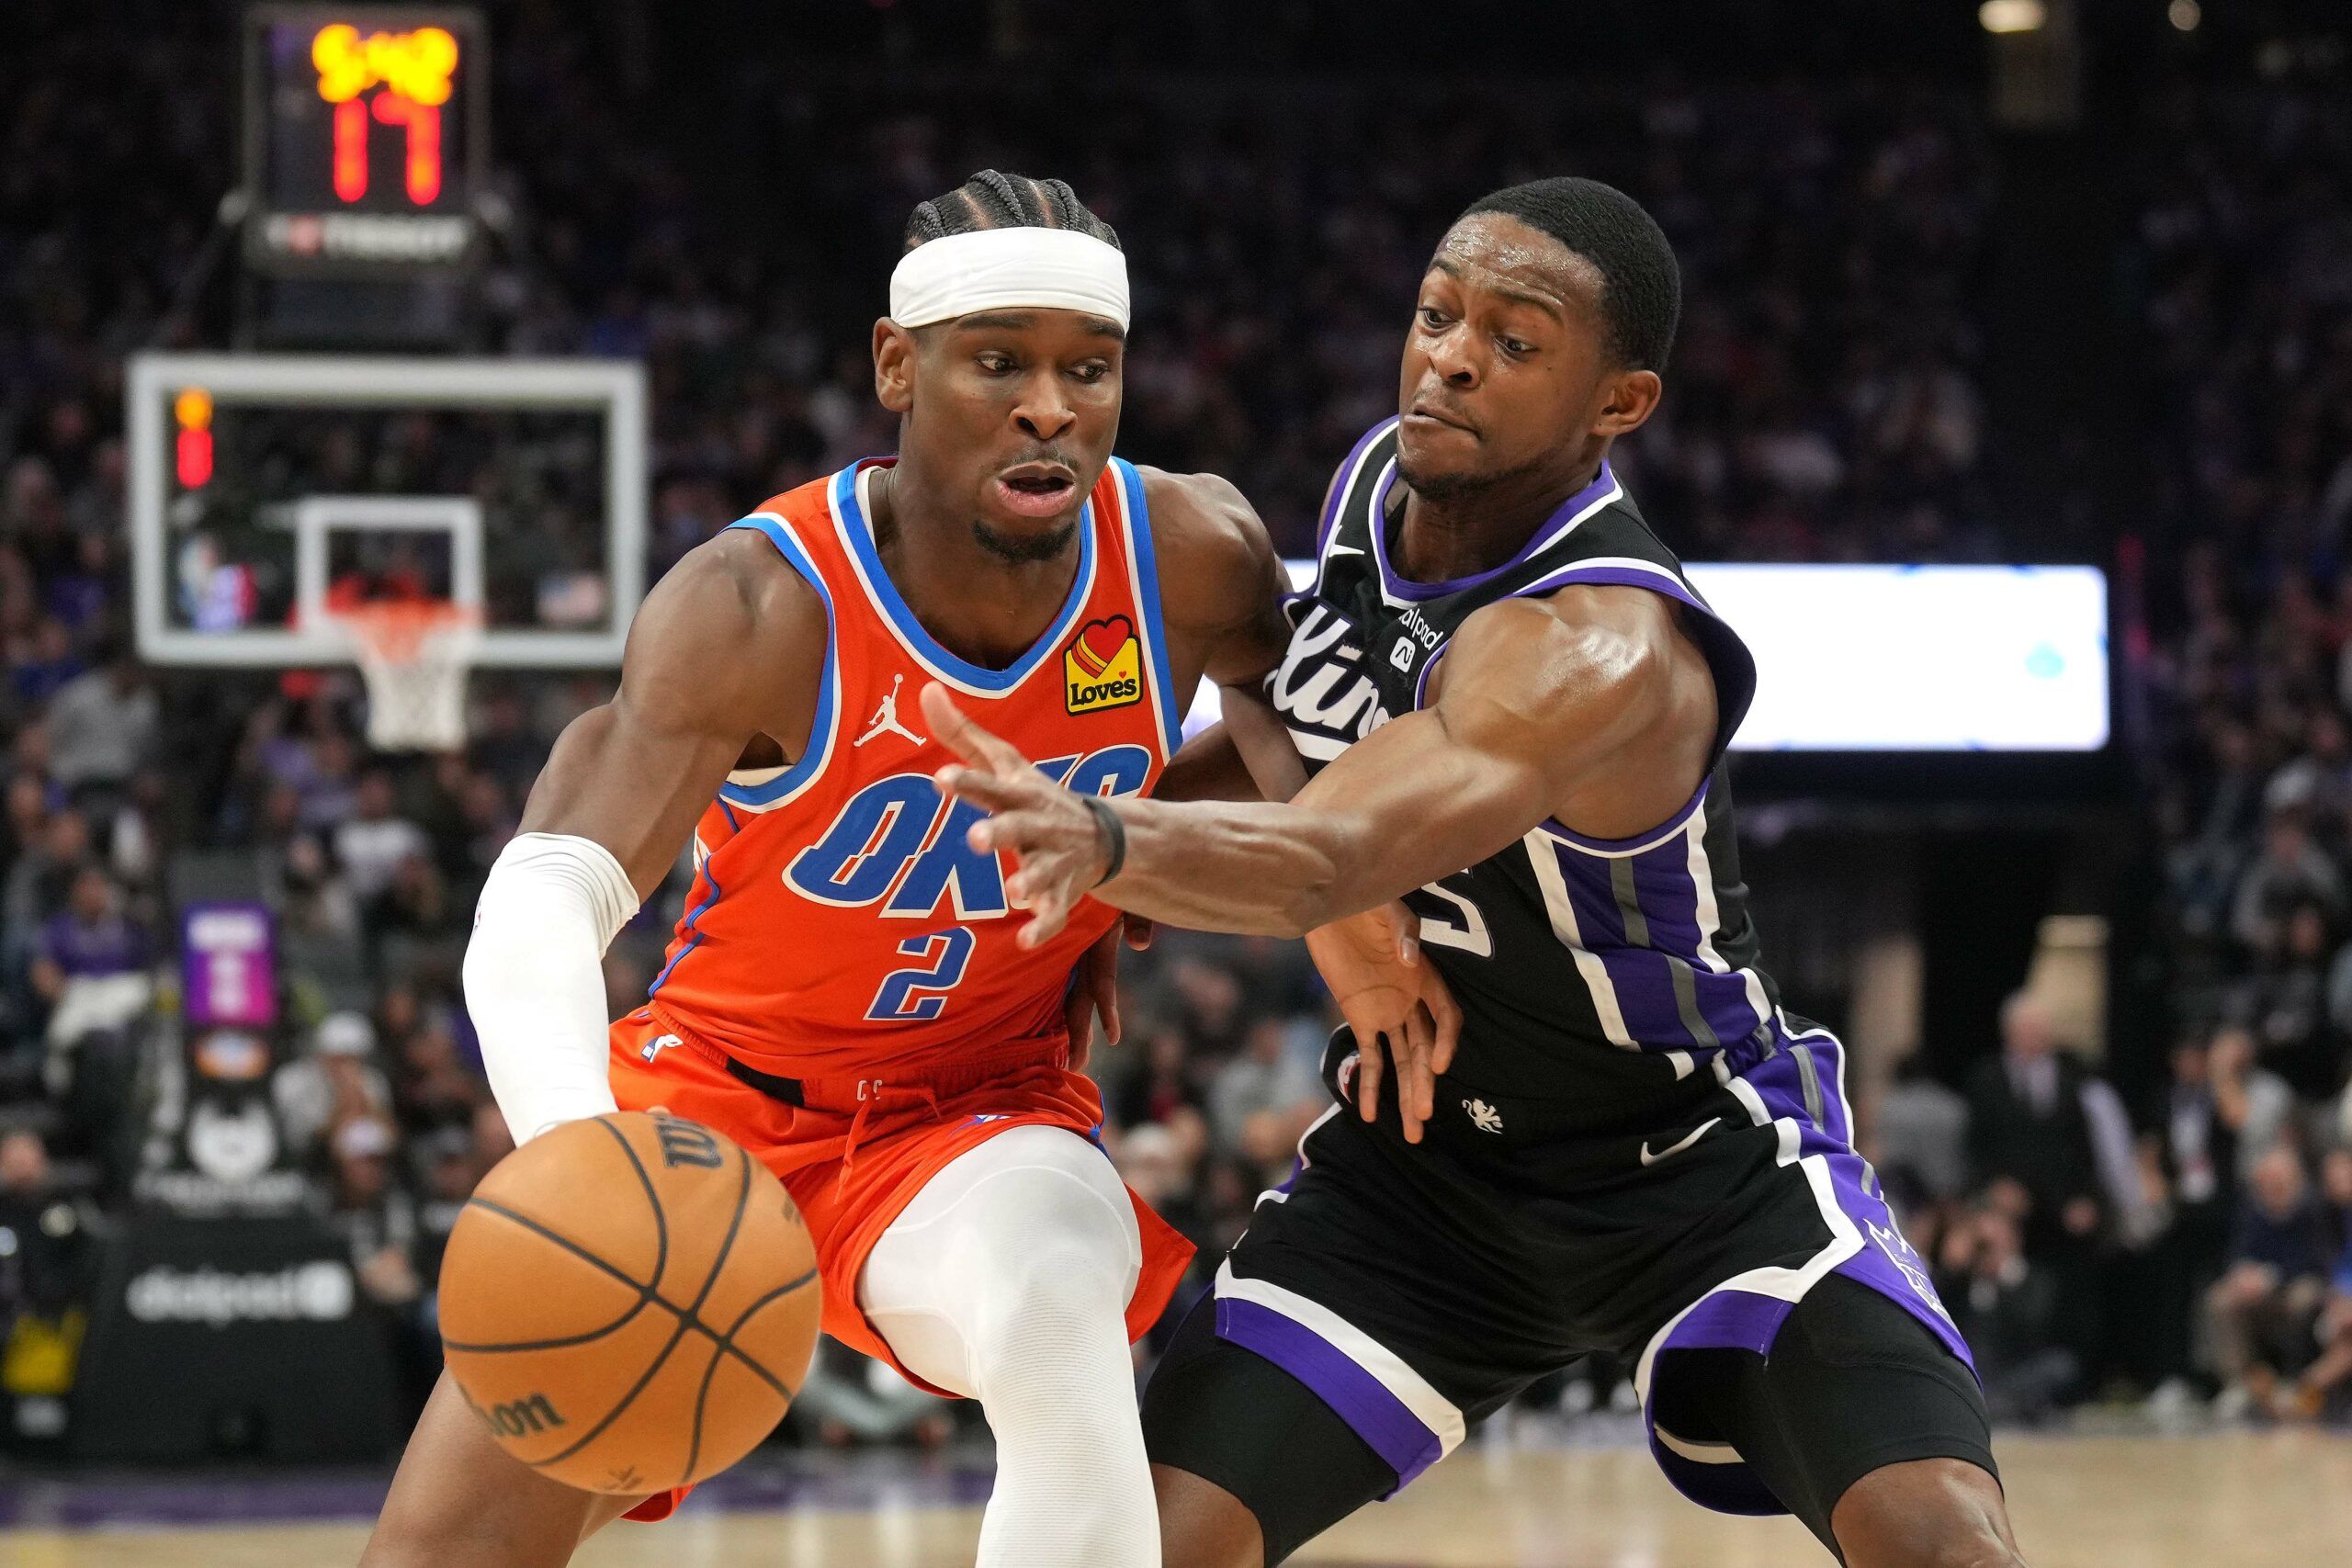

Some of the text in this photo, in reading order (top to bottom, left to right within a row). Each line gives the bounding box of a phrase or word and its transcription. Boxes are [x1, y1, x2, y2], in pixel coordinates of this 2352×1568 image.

[334, 93, 442, 206] 17
[1263, 604, 1394, 741] Kin
[1398, 607, 1444, 651] alpad
[862, 925, 978, 1021] 2
